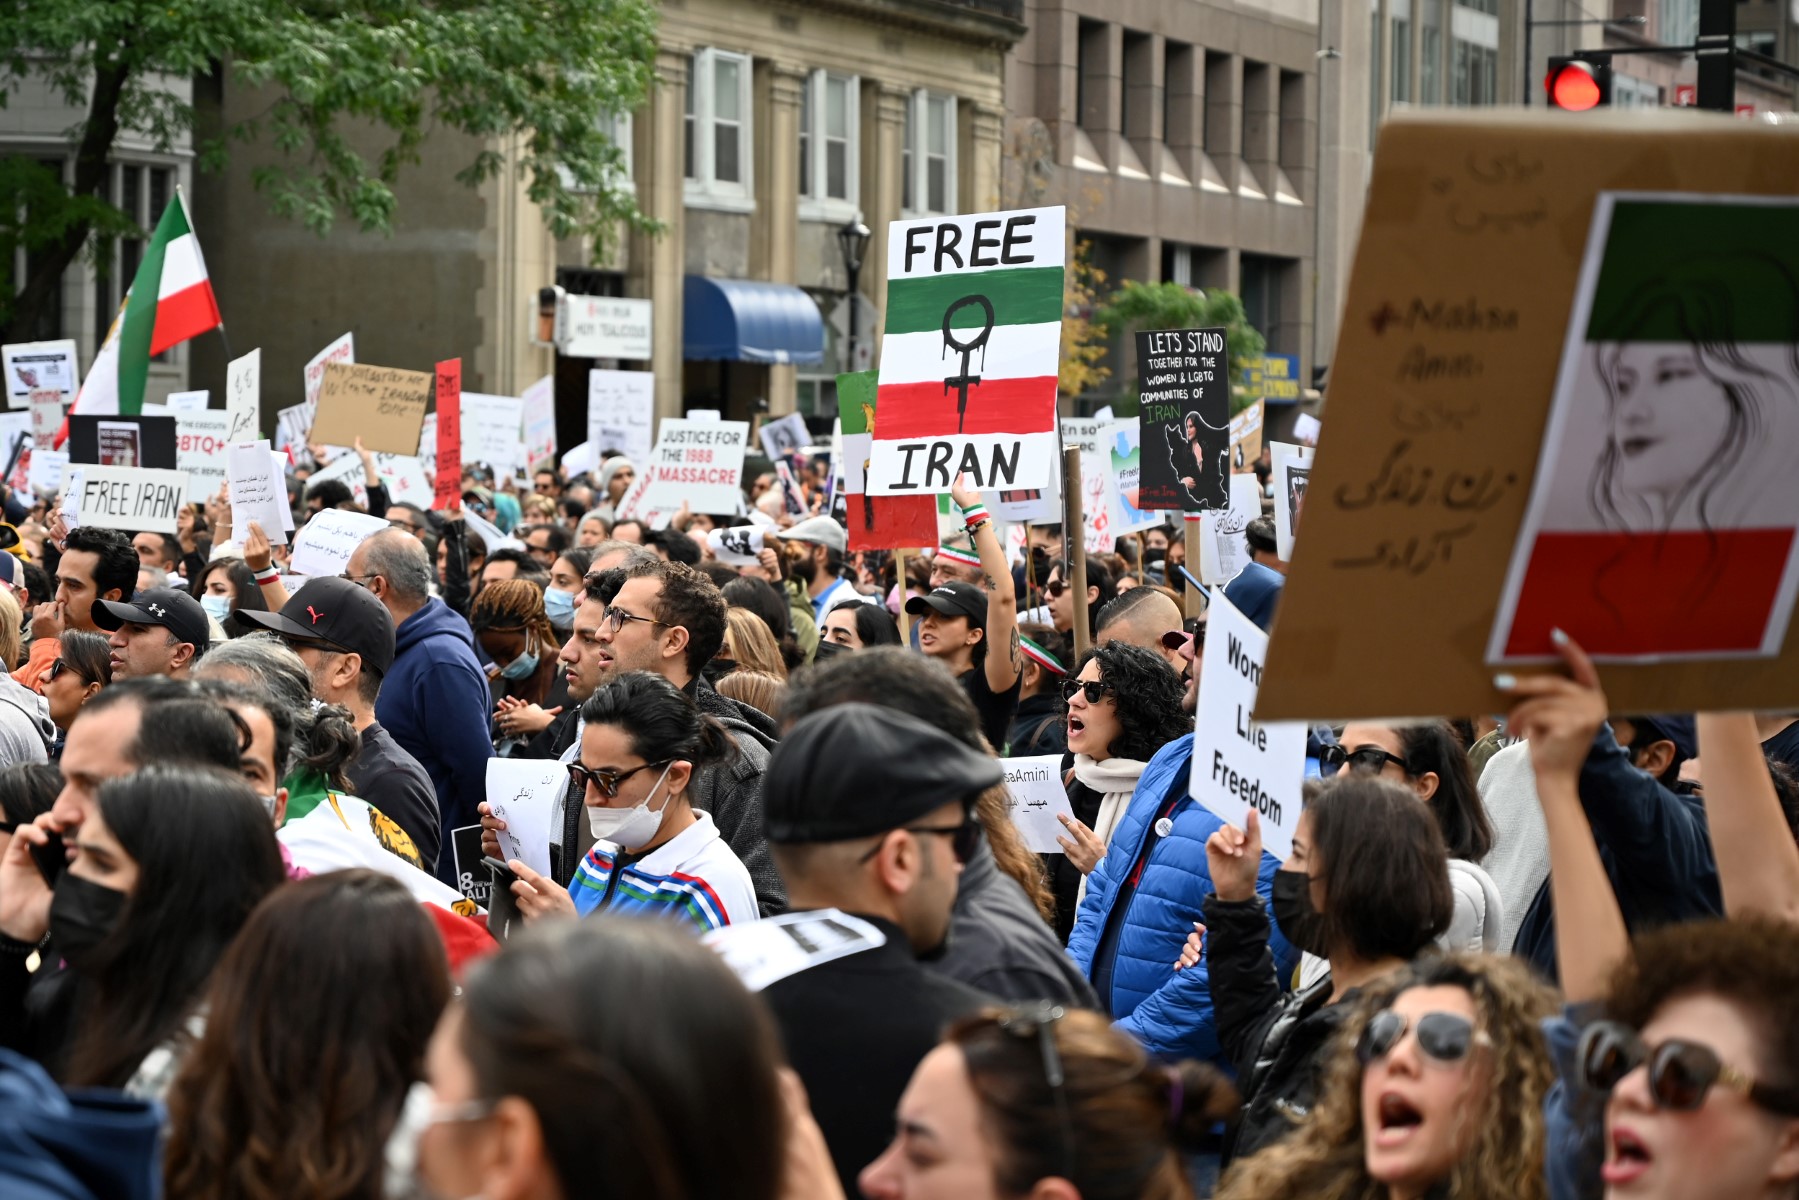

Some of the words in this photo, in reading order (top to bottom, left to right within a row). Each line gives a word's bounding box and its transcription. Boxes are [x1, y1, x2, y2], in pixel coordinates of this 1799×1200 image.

[904, 214, 1037, 273] FREE
[1148, 332, 1182, 354] LET'S
[1187, 331, 1223, 353] STAND
[1148, 357, 1182, 369] TOGETHER
[1185, 357, 1197, 367] FOR
[1201, 357, 1216, 367] THE
[1146, 374, 1177, 386] WOMEN
[1180, 372, 1186, 383] &
[1188, 371, 1214, 383] LGBTQ
[1140, 389, 1189, 404] COMMUNITIES
[1193, 388, 1204, 399] OF
[1145, 403, 1181, 424] IRAN
[664, 430, 712, 444] JUSTICE
[714, 431, 740, 445] FOR
[1061, 424, 1077, 435] En
[662, 448, 682, 462] THE
[685, 449, 713, 463] 1988
[888, 440, 1021, 490] IRAN
[658, 467, 736, 484] MASSACRE
[82, 480, 130, 515] FREE
[133, 482, 181, 519] IRAN
[541, 774, 554, 785] زن
[513, 787, 534, 801] زندگی
[1211, 749, 1282, 827] Freedom
[461, 871, 474, 890] 8
[467, 887, 486, 900] ALI
